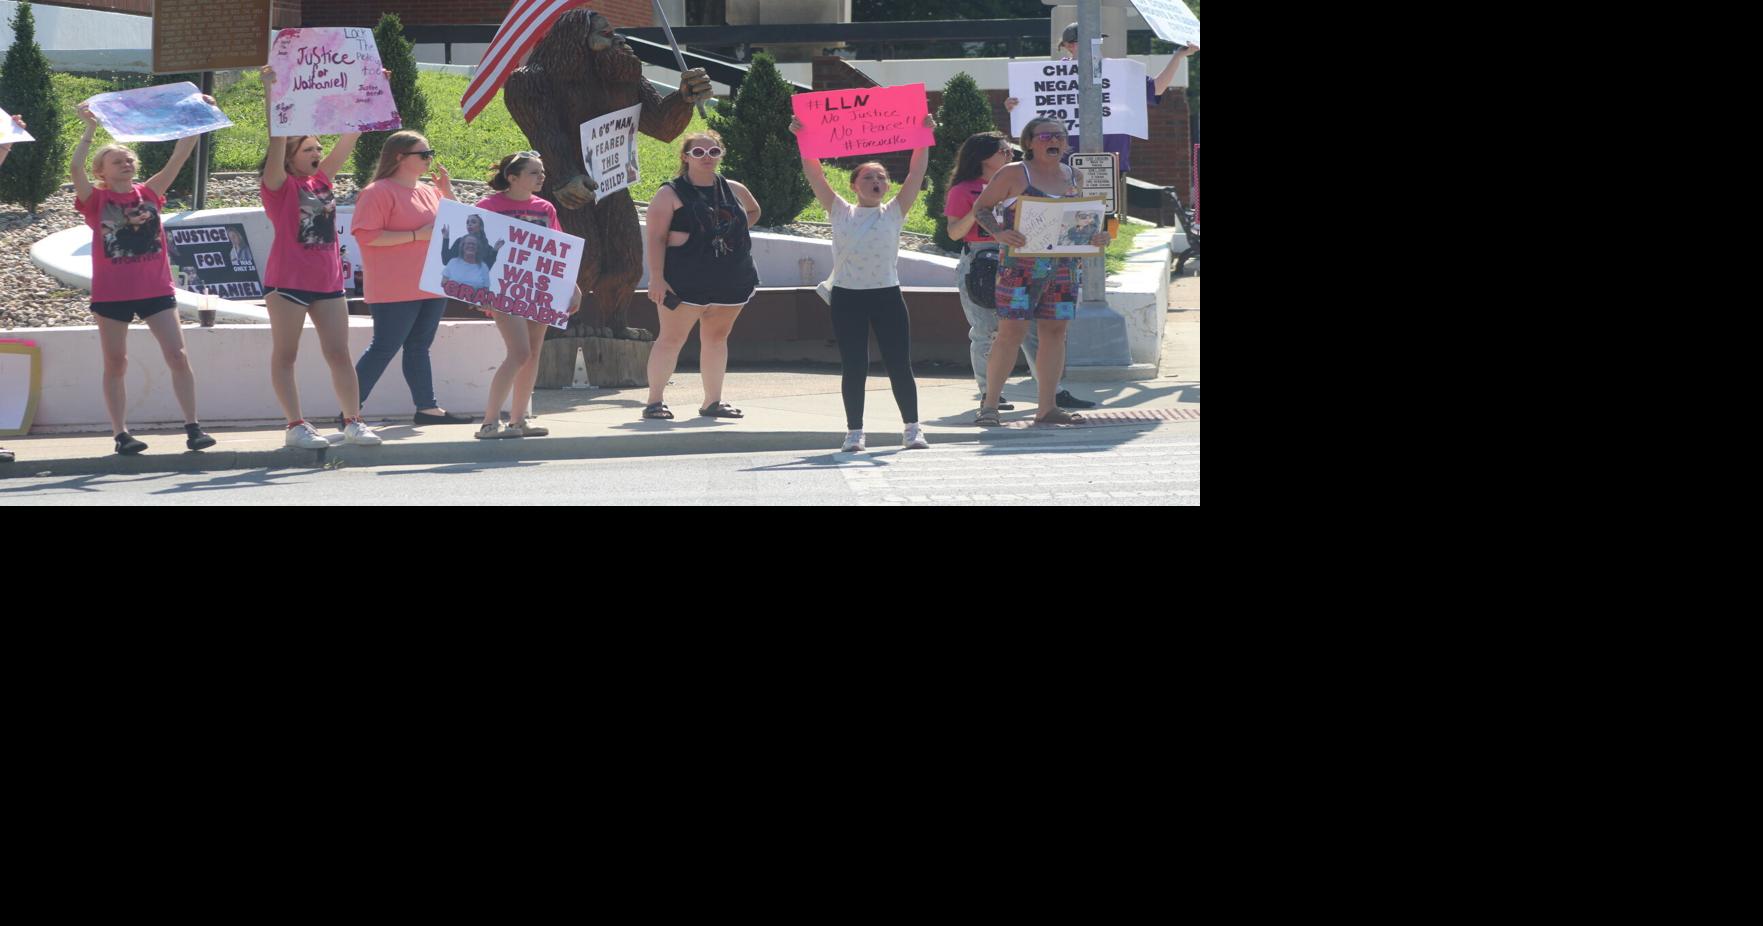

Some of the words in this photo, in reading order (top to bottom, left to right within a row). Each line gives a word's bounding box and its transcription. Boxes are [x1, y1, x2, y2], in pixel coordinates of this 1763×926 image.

[312, 63, 328, 79] for
[1043, 64, 1079, 76] CHA
[1034, 78, 1111, 92] NEGAS
[1035, 92, 1111, 106] DEFEE
[821, 114, 840, 125] No
[850, 108, 899, 121] Justice
[591, 127, 597, 140] A
[830, 125, 853, 143] No
[595, 134, 625, 157] FEARED
[601, 153, 619, 170] THIS
[600, 172, 625, 193] CHILD?
[174, 228, 229, 245] JUSTICE
[509, 225, 571, 259] WHAT
[197, 253, 225, 268] FOR
[508, 247, 531, 265] IF
[535, 256, 567, 279] HE
[503, 264, 551, 292] WAS
[498, 278, 554, 307] YOUR
[443, 280, 569, 326] GRANDBABY?
